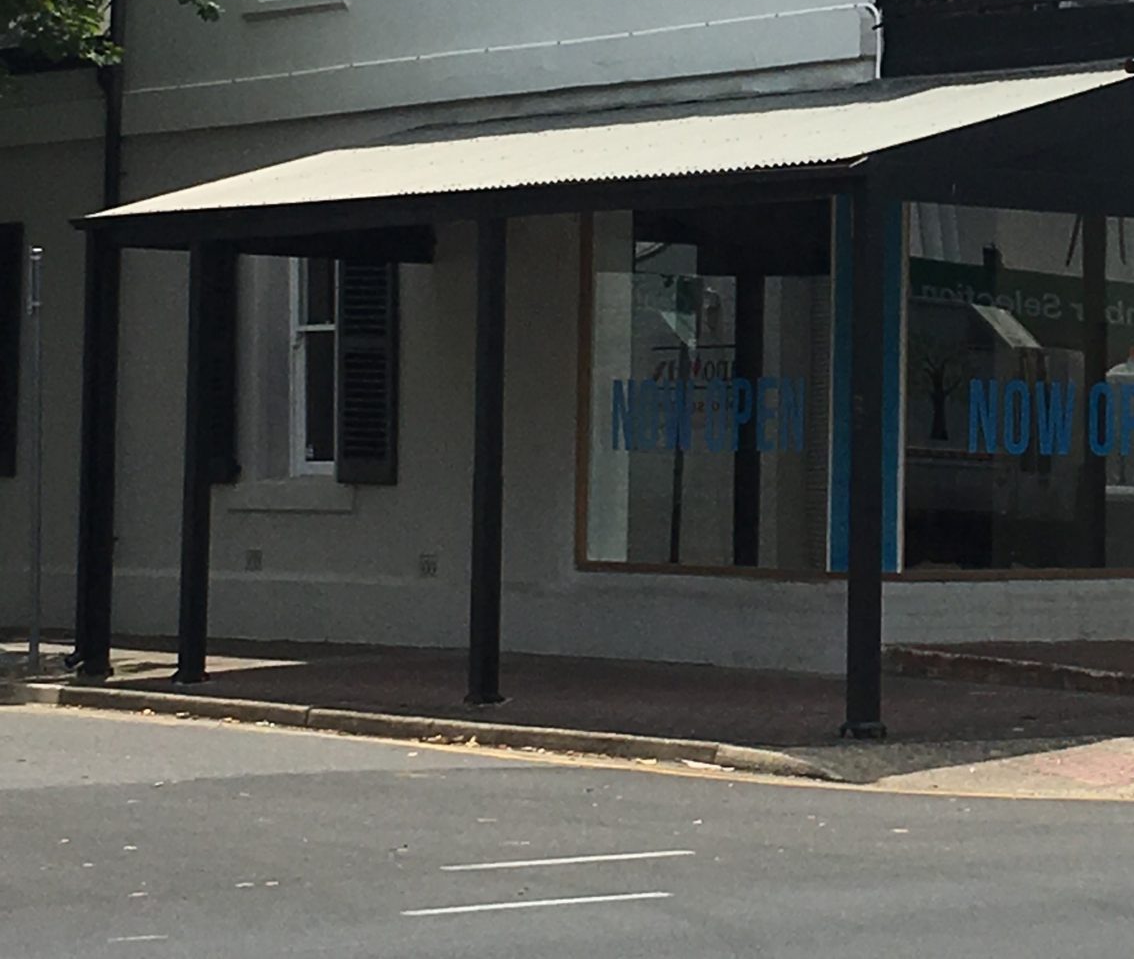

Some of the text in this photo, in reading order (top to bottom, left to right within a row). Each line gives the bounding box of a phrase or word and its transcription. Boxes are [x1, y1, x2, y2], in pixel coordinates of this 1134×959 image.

[612, 376, 804, 454] NOW OPEN
[968, 378, 1075, 457] NOW
